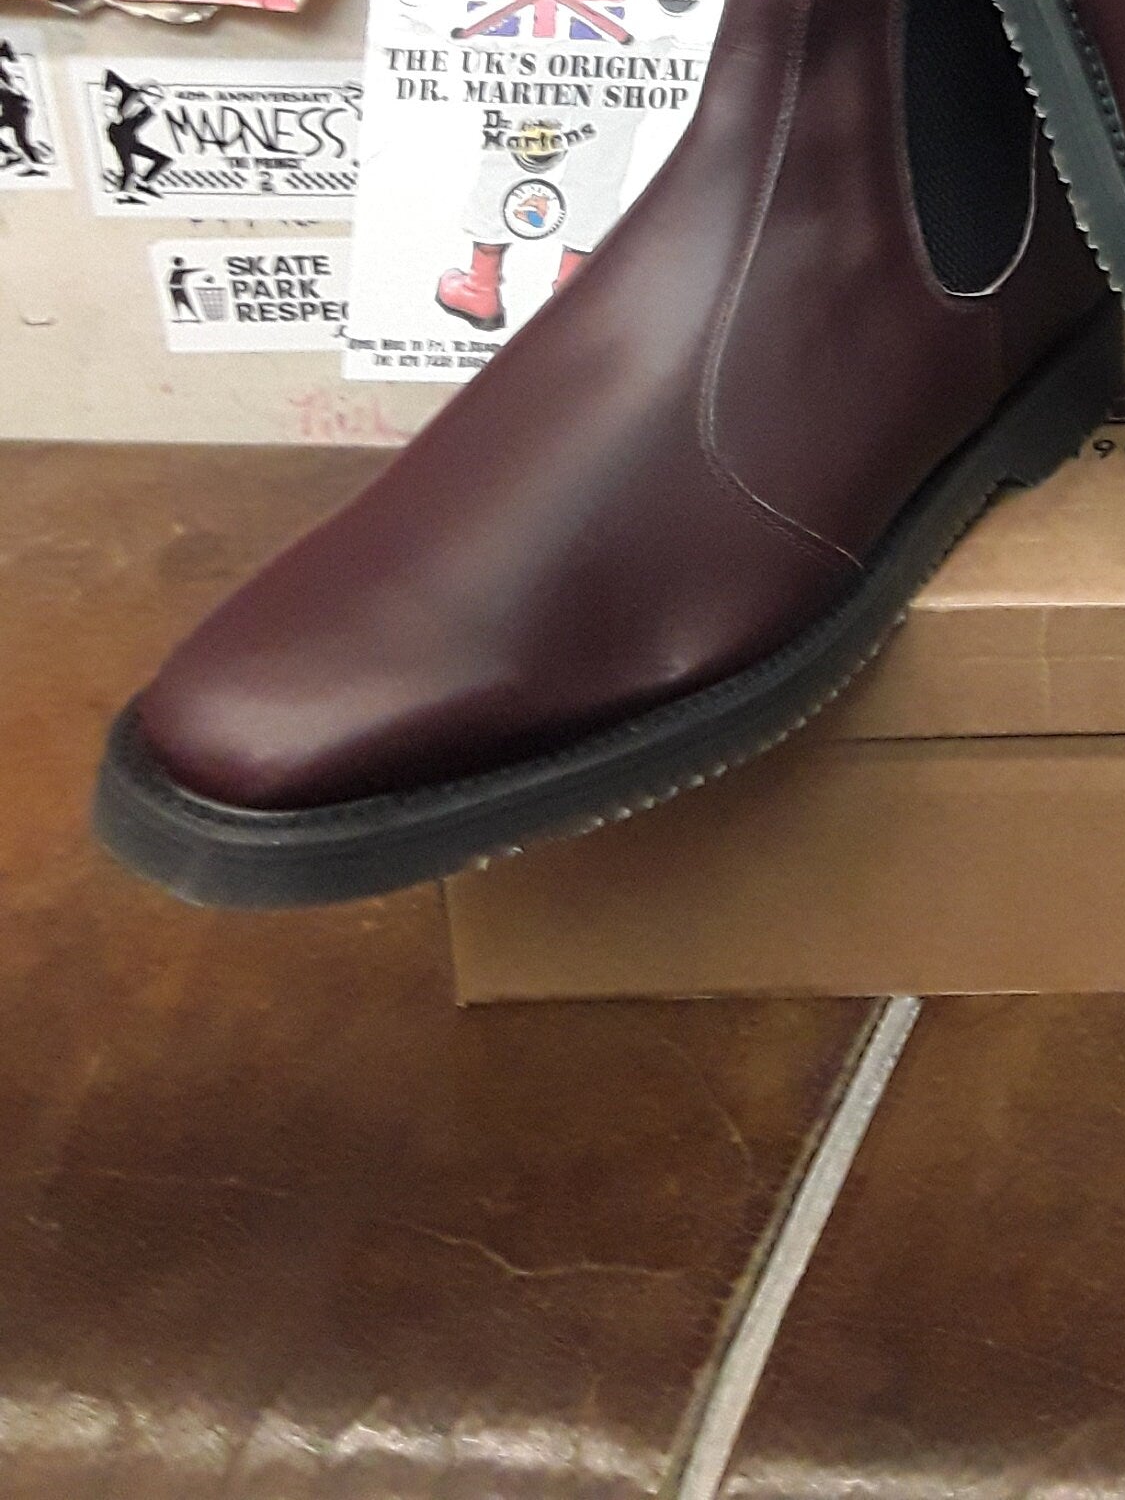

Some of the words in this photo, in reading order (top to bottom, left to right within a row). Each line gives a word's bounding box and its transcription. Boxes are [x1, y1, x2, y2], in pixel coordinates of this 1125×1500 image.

[386, 48, 449, 71] THE
[461, 50, 538, 77] UK'S
[548, 53, 700, 82] ORIGINAL
[397, 76, 450, 102] DR.
[462, 80, 592, 107] MARTEN
[603, 84, 689, 110] SHOP
[162, 104, 348, 159] MADNESS
[225, 255, 332, 276] SKATE
[231, 279, 322, 299] PARK
